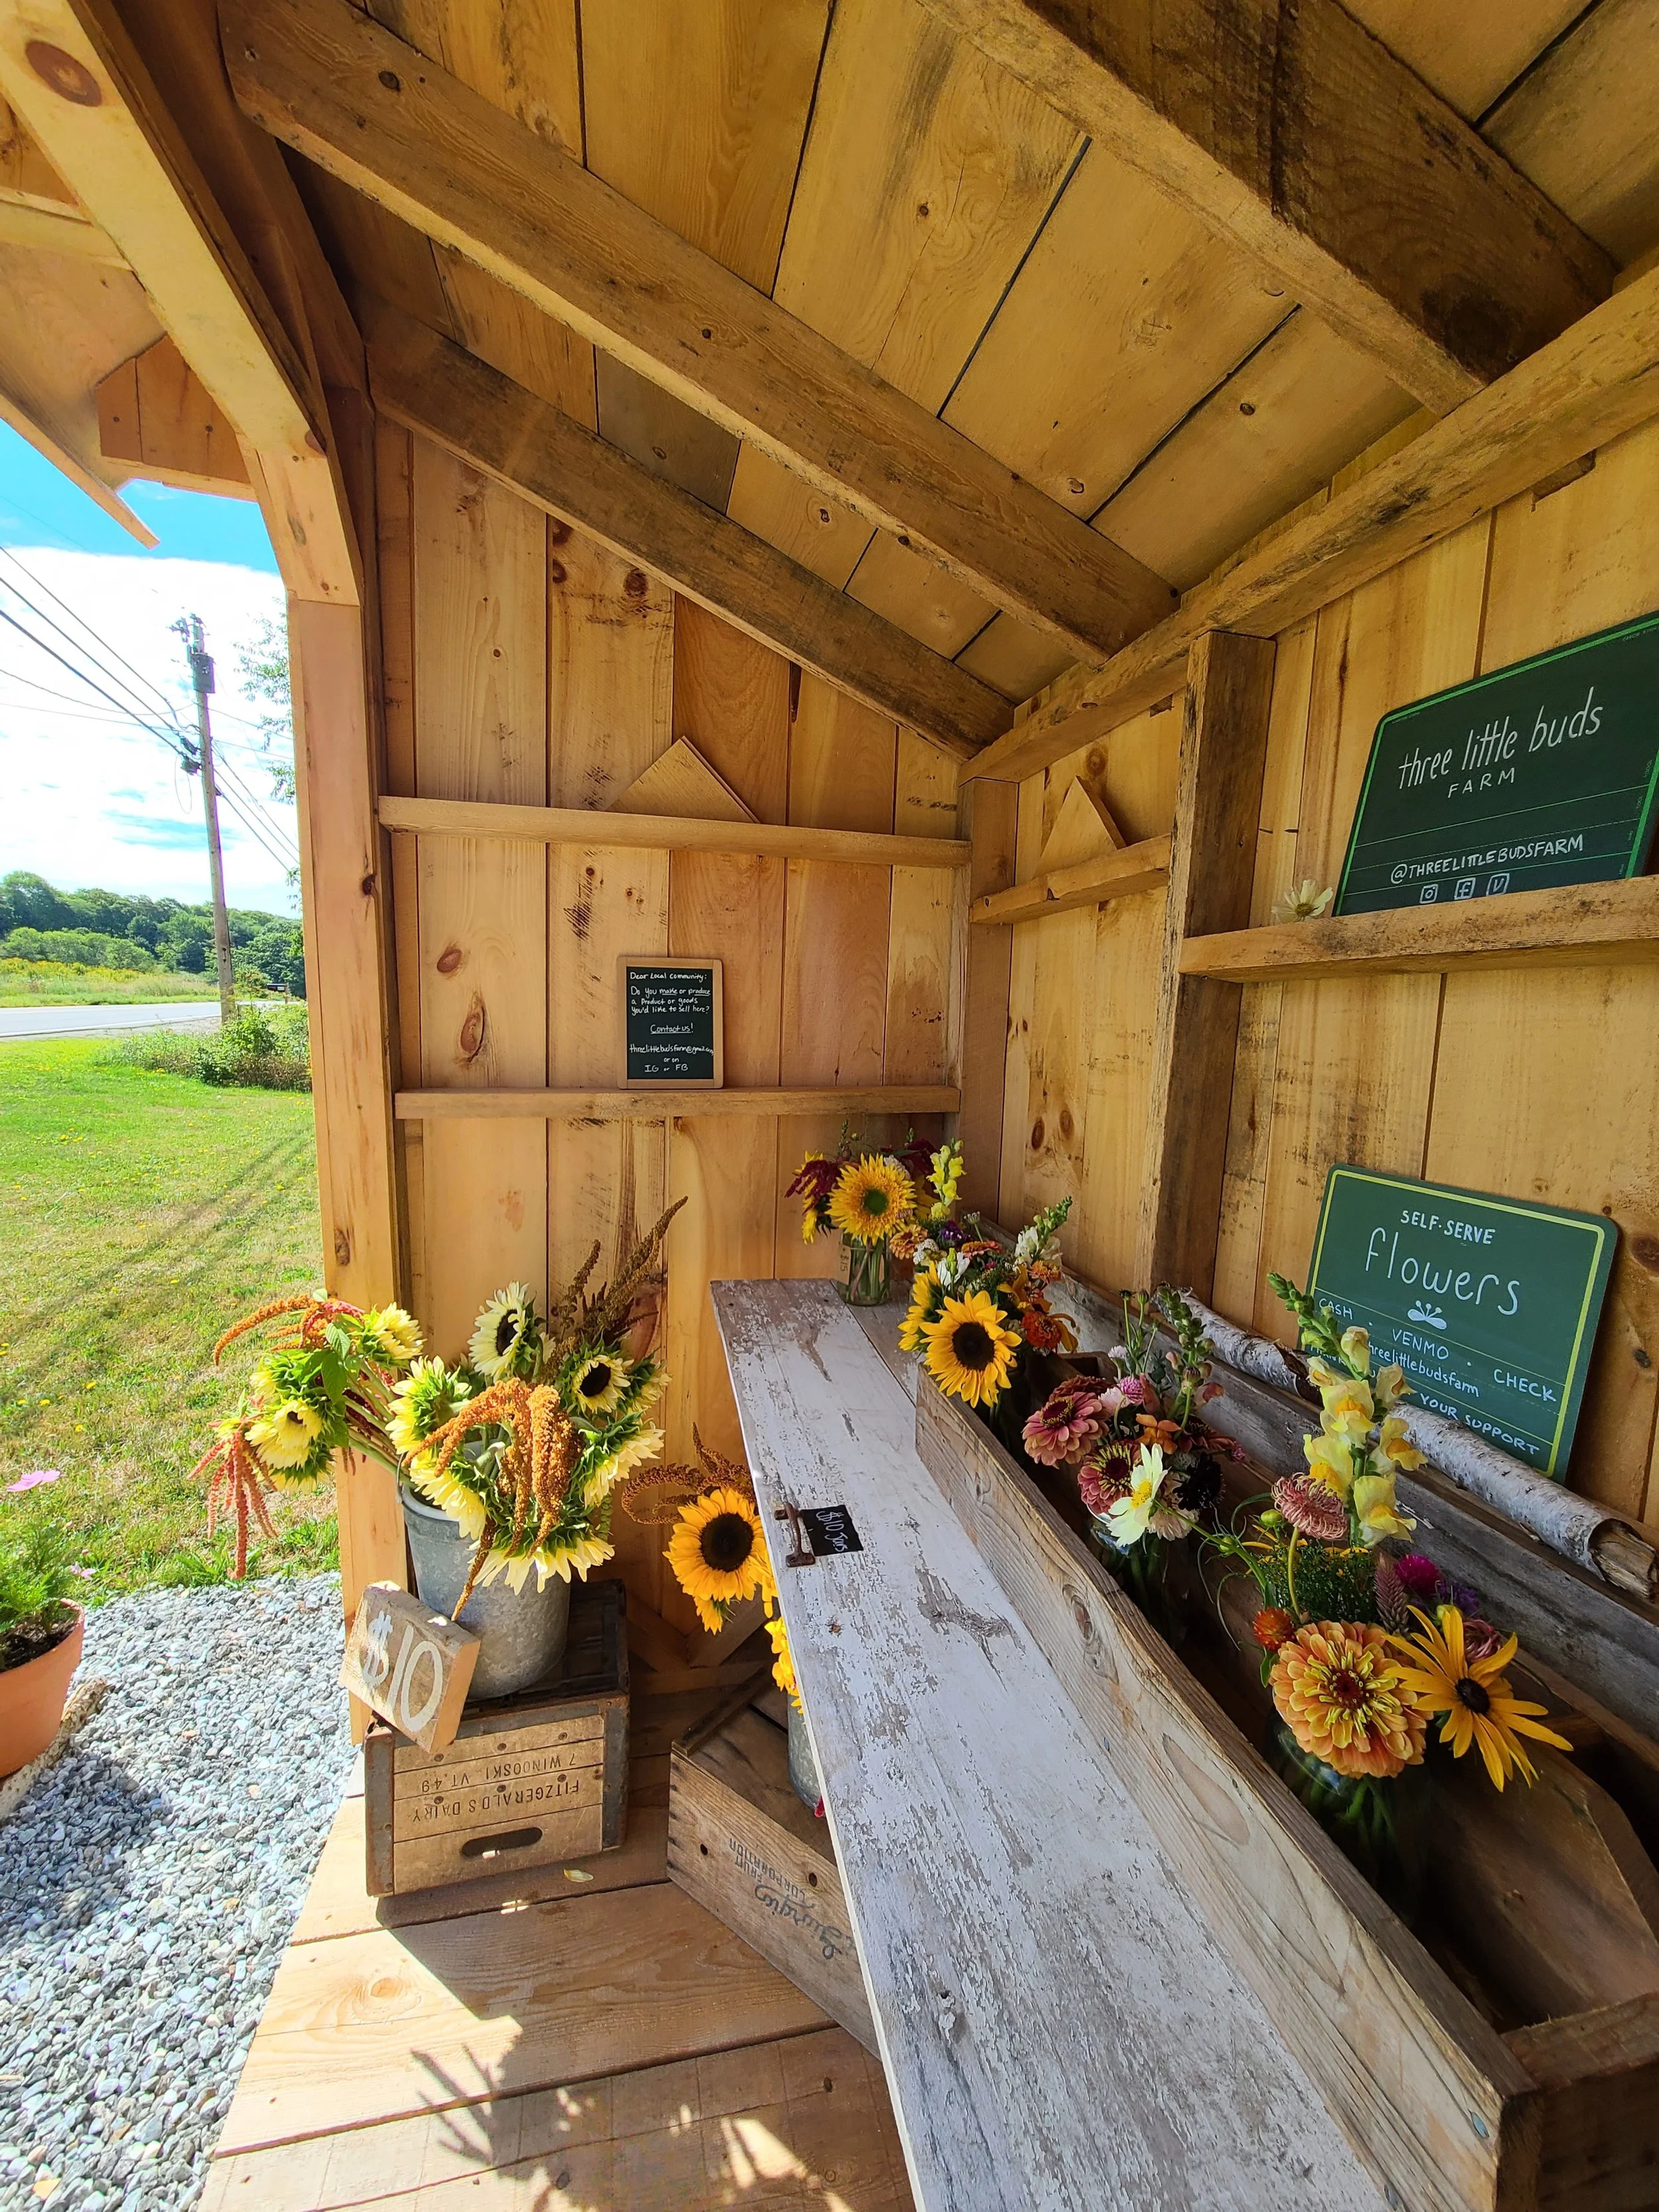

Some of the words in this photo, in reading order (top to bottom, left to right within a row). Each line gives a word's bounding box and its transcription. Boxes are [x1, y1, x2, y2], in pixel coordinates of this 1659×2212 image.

[1398, 747, 1453, 789] three
[1461, 715, 1518, 771] little
[1528, 686, 1603, 753] buds
[1447, 767, 1515, 798] FARM
[1390, 834, 1583, 884] @THREELITTLEBUDSFARM
[630, 986, 640, 995] Do
[644, 987, 658, 999] you
[659, 987, 678, 995] make
[687, 987, 711, 996] produce
[678, 997, 698, 1007] goods
[692, 1005, 710, 1014] here?
[650, 1024, 681, 1034] Contact
[681, 1022, 694, 1033] us!
[840, 1254, 849, 1272] $15
[1365, 1226, 1520, 1316] flowers
[1319, 1297, 1353, 1320] CASH
[1392, 1328, 1449, 1361] VENMO
[1494, 1368, 1557, 1402] CHECK
[1419, 1392, 1459, 1421] YOUR
[1464, 1414, 1540, 1455] SUPPORT
[816, 1511, 845, 1531] $10
[359, 1610, 443, 1733] $10
[485, 1755, 561, 1780] WINOOSKI
[411, 1801, 461, 1823] DAIRY
[727, 1837, 806, 1905] CORPORATION
[734, 1856, 762, 1883] FRUIT
